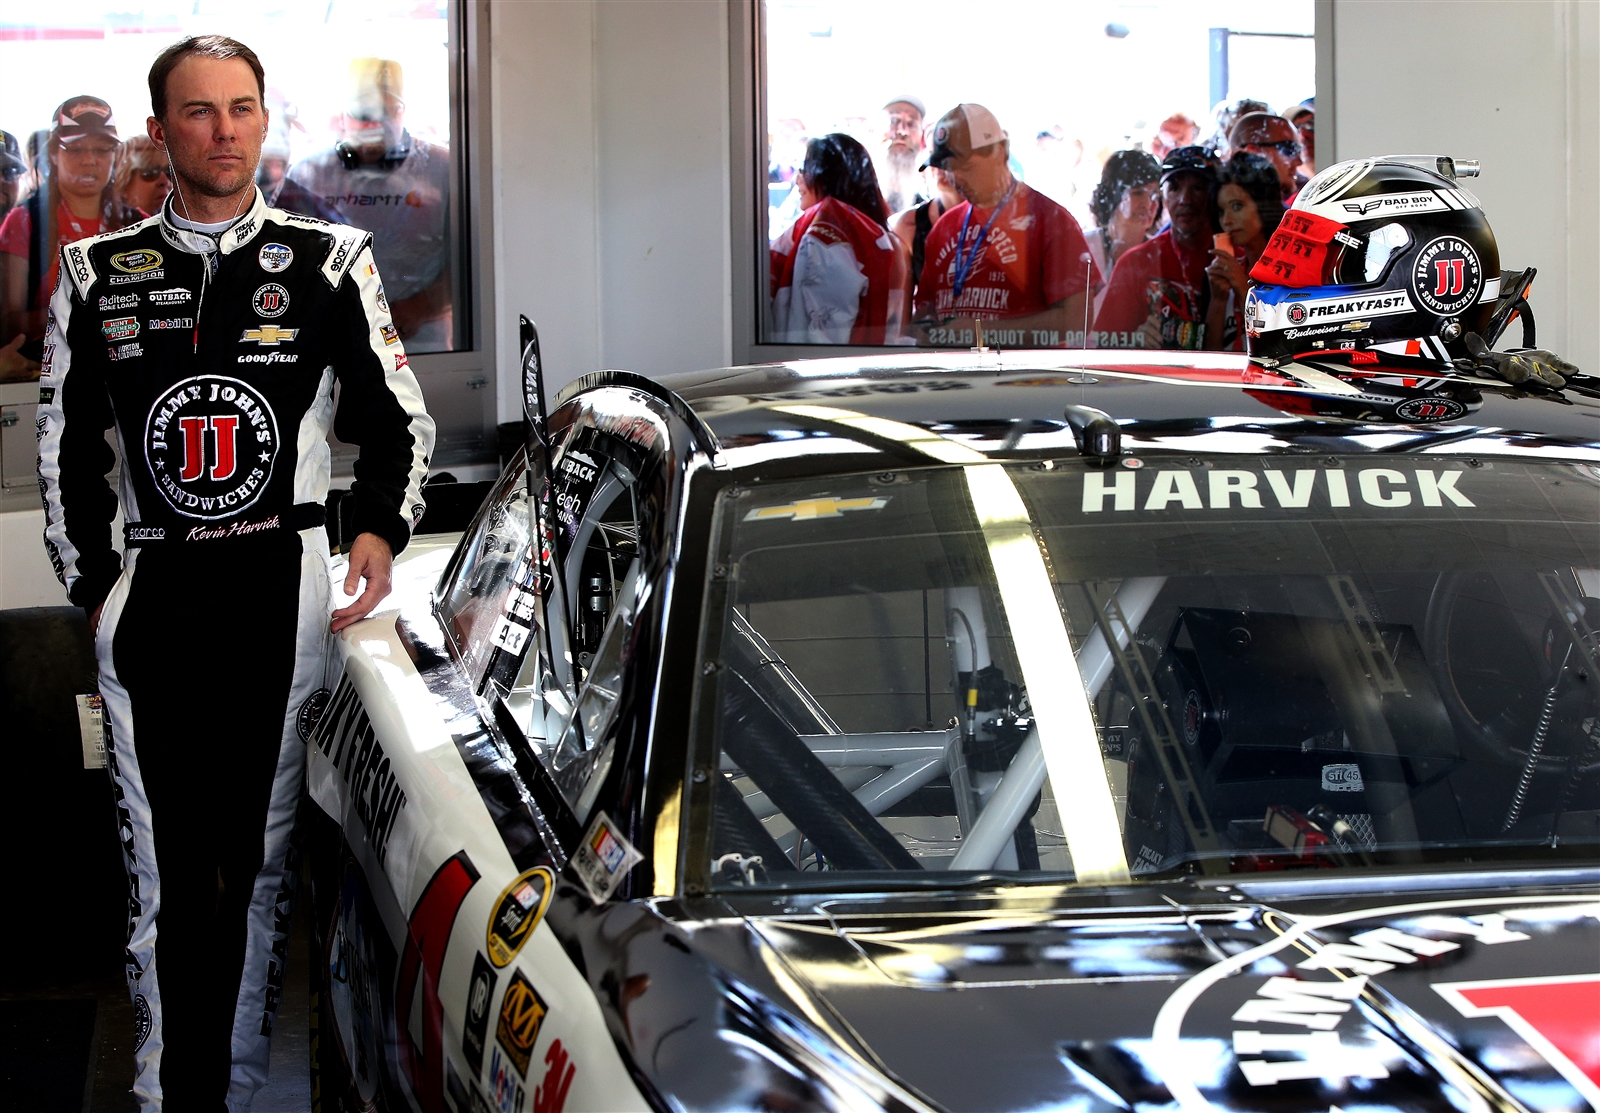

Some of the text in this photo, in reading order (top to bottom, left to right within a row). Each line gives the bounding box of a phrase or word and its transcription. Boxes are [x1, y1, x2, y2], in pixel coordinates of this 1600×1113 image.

[1384, 195, 1433, 206] BAD BOY
[262, 250, 291, 260] BUSCH
[965, 224, 982, 241] FO
[986, 227, 1018, 264] SPEED
[70, 245, 89, 282] sparco
[1417, 241, 1478, 278] JIMMY JOHN'S
[110, 271, 164, 283] CHAMPION
[1434, 259, 1466, 296] JJ
[149, 293, 192, 301] OUTBACK
[262, 293, 280, 309] JJ
[1422, 286, 1475, 312] SANDWICHES
[149, 319, 181, 329] Mobil
[1284, 326, 1339, 340] Budweiser
[238, 352, 298, 366] GOODYEAR
[153, 384, 271, 450] JIMMY JOHN'S
[179, 415, 240, 483] JJ
[161, 467, 264, 510] SANDWICHES
[1081, 468, 1477, 513] HARVICK
[186, 515, 278, 542] Kevin Harvick
[1139, 844, 1164, 866] FREAKY
